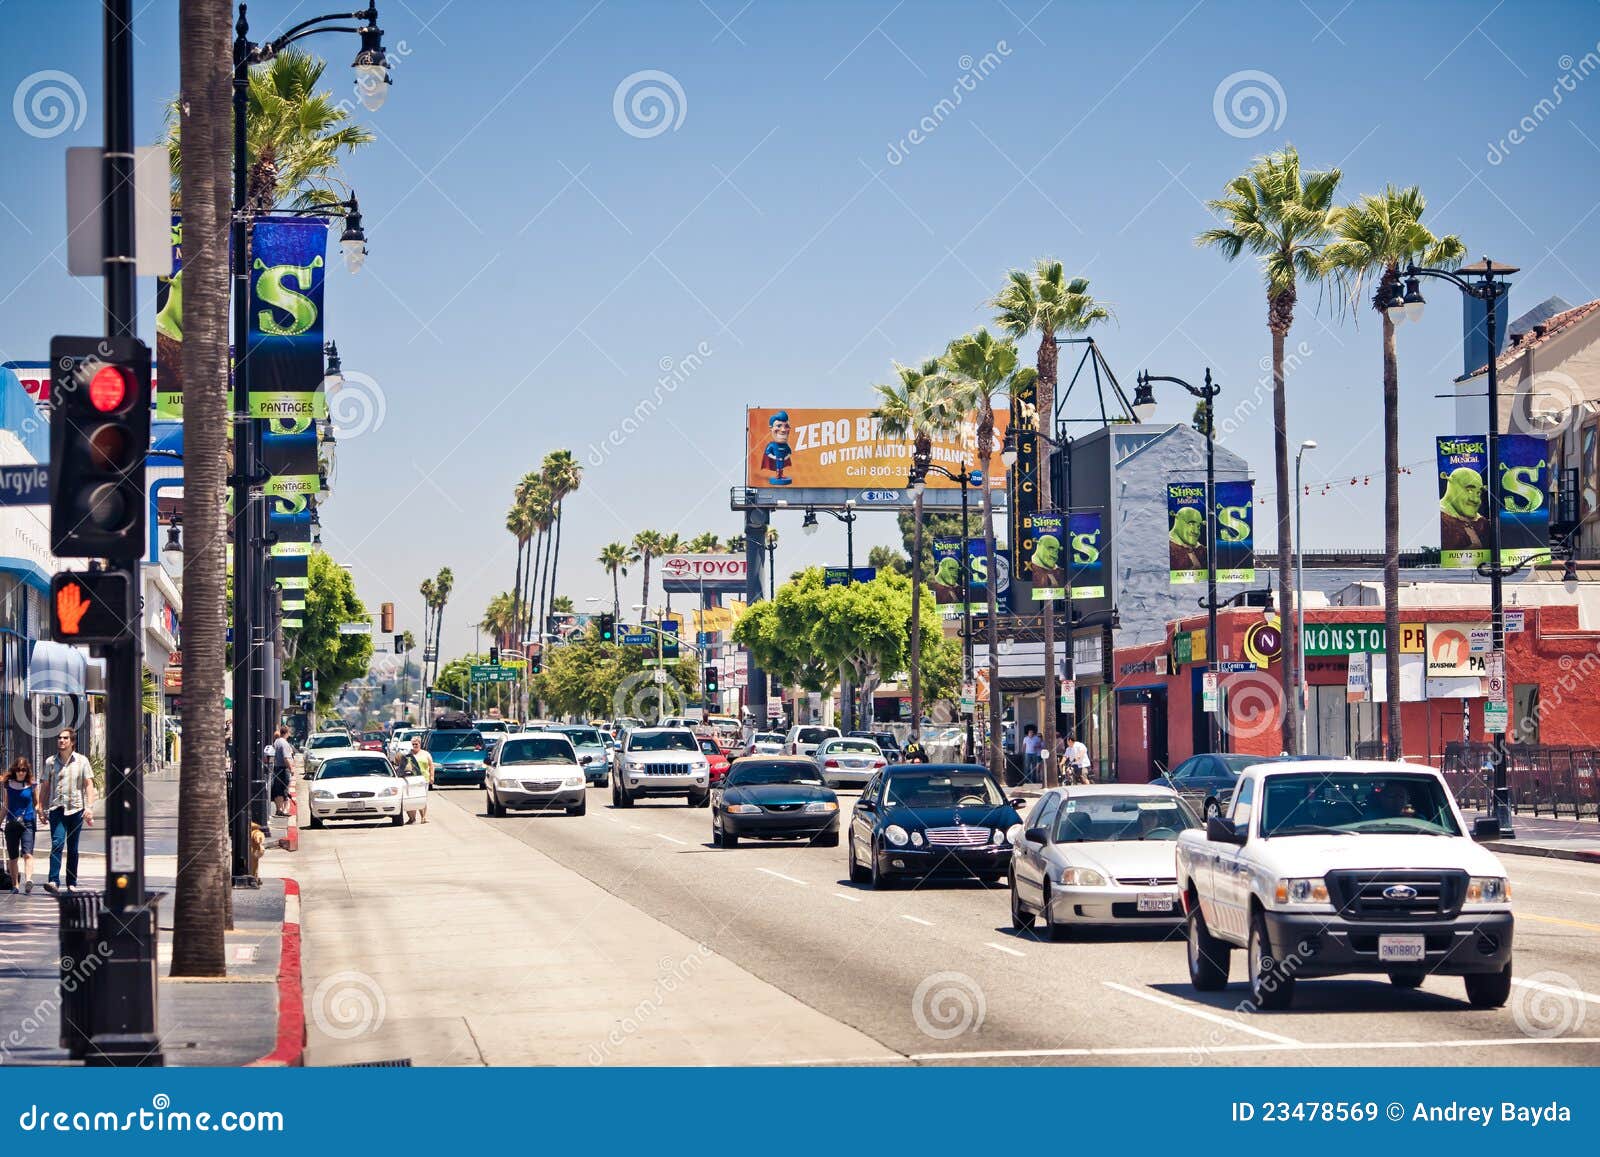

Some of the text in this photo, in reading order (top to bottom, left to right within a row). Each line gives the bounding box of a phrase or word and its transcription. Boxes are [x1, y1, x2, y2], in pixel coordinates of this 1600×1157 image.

[260, 402, 314, 413] PANTAGES
[795, 419, 850, 451] ZERO
[820, 452, 837, 466] ON
[839, 446, 872, 461] TITAN
[875, 445, 905, 458] AUTO
[846, 466, 866, 476] Call
[0, 470, 48, 495] Argyle
[272, 482, 312, 491] PANTAGES
[693, 561, 747, 573] TOYOT
[1304, 629, 1386, 650] NONSTO
